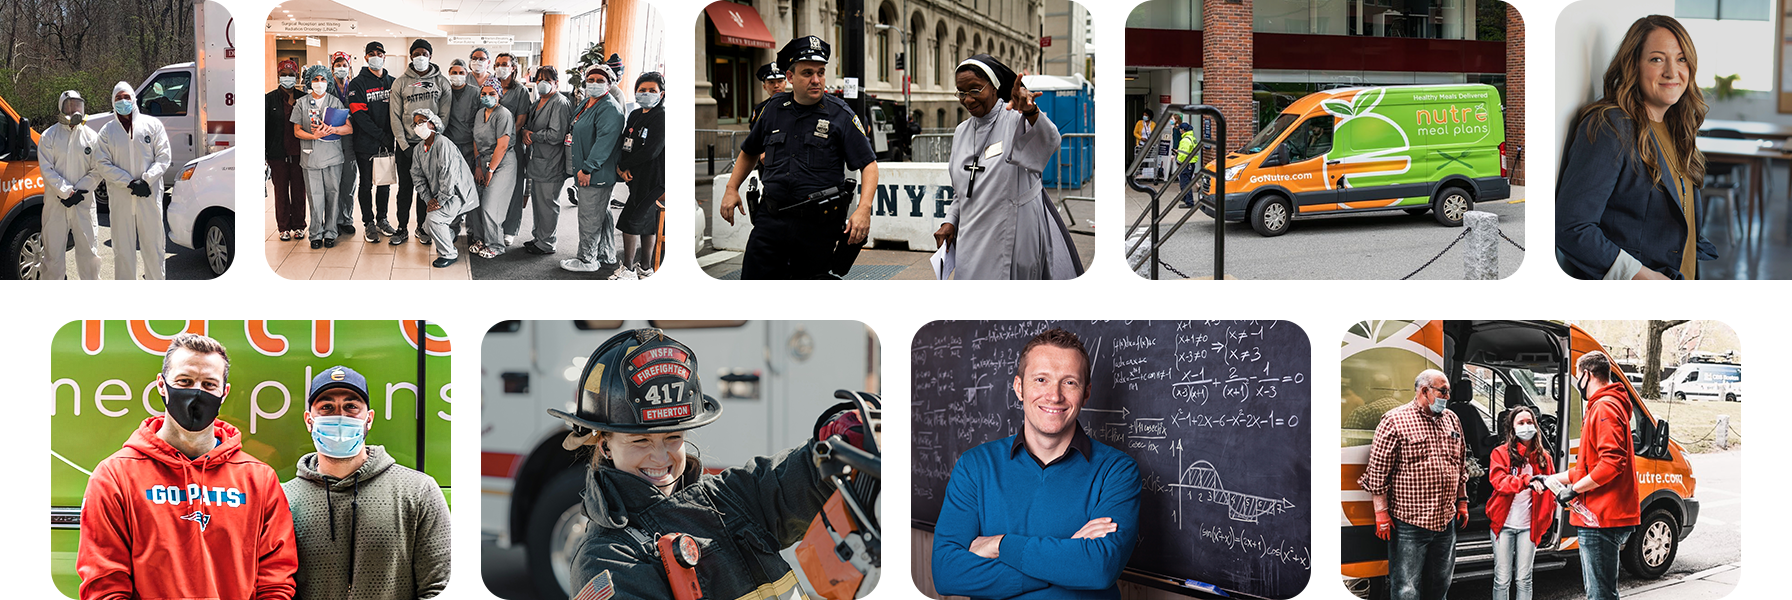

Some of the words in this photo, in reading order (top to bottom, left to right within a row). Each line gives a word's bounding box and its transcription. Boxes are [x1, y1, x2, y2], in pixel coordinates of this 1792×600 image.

[366, 89, 392, 102] PATRIOT
[406, 91, 439, 103] PATRIOTS
[1418, 125, 1449, 136] meal
[1453, 124, 1488, 137] plans
[1249, 172, 1313, 184] GoNutre.com
[649, 348, 674, 359] WSFR
[636, 364, 687, 382] FIREFIGHTER
[644, 381, 685, 405] 417
[646, 406, 688, 420] ETHERTON
[151, 484, 181, 506] GO
[186, 483, 241, 508] PATS
